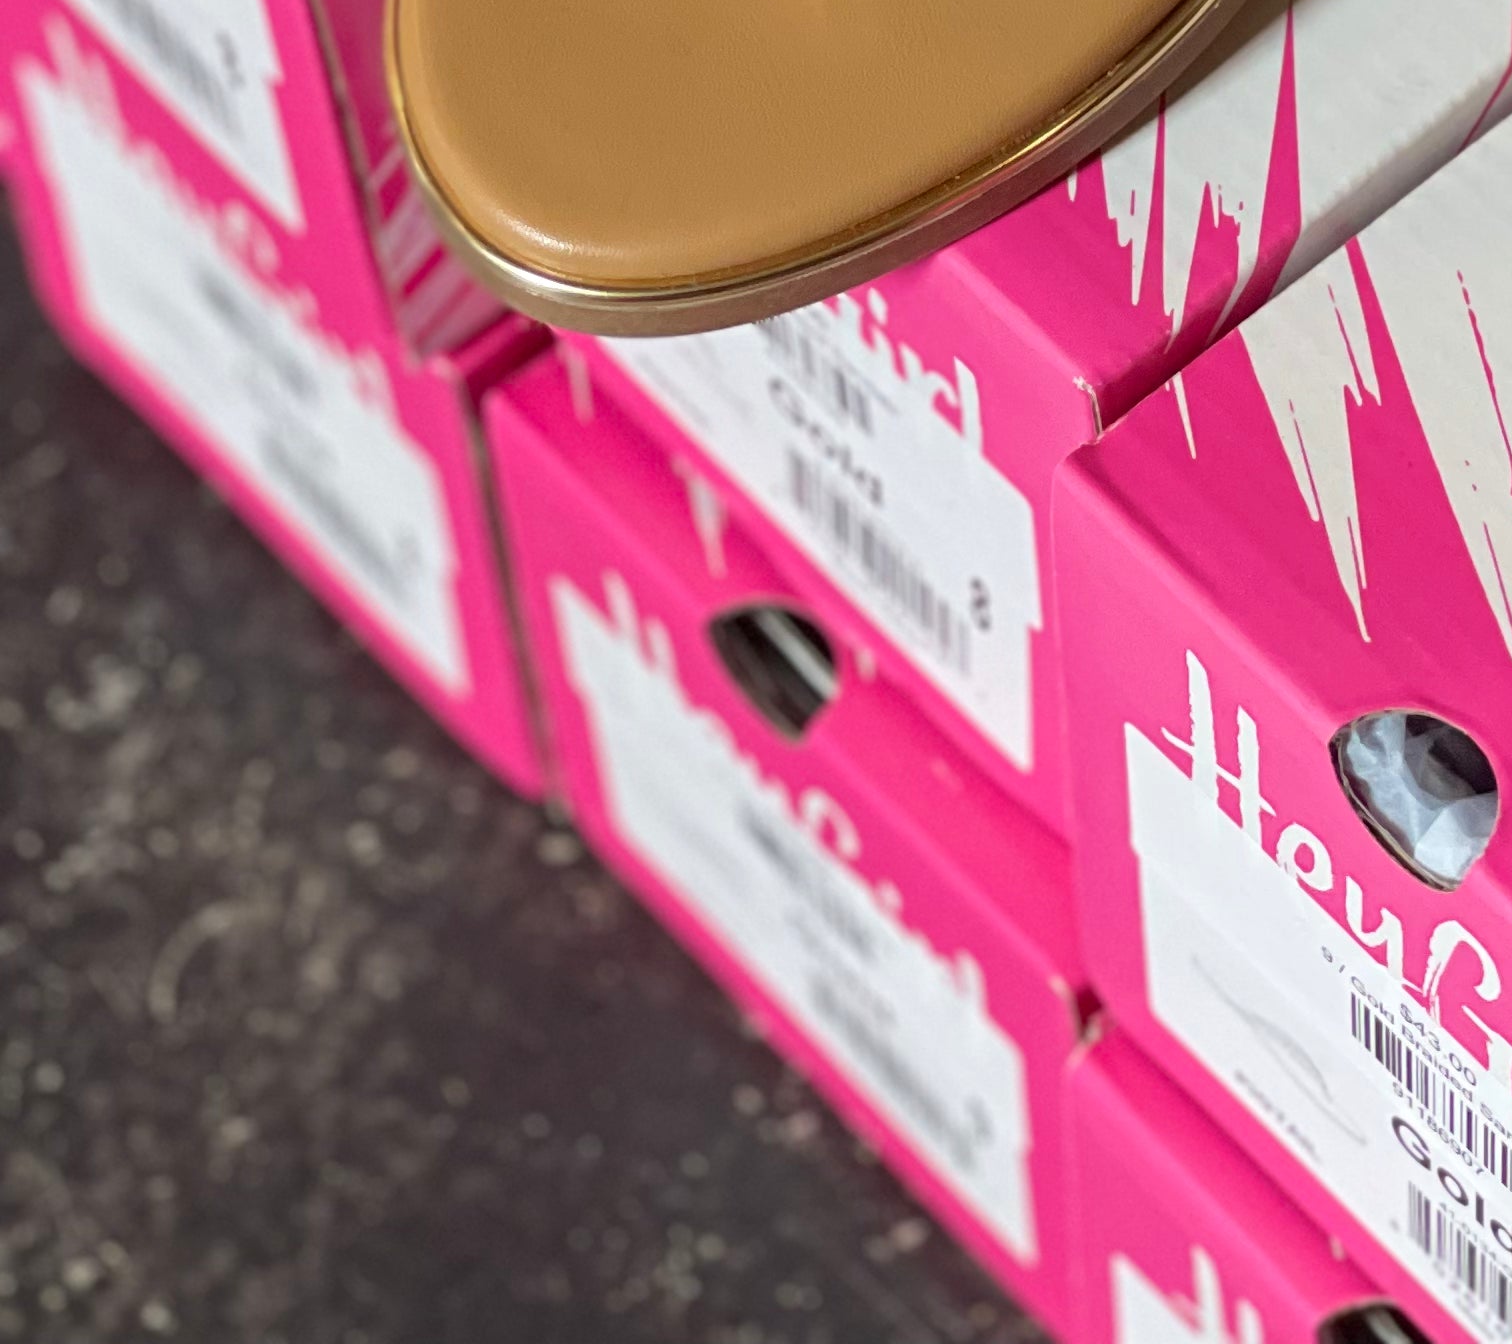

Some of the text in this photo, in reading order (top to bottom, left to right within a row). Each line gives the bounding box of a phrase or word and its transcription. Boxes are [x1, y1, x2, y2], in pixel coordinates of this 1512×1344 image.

[1351, 975, 1396, 1025] Gold
[1402, 1024, 1473, 1103] Braided
[1400, 1002, 1477, 1088] $43.00
